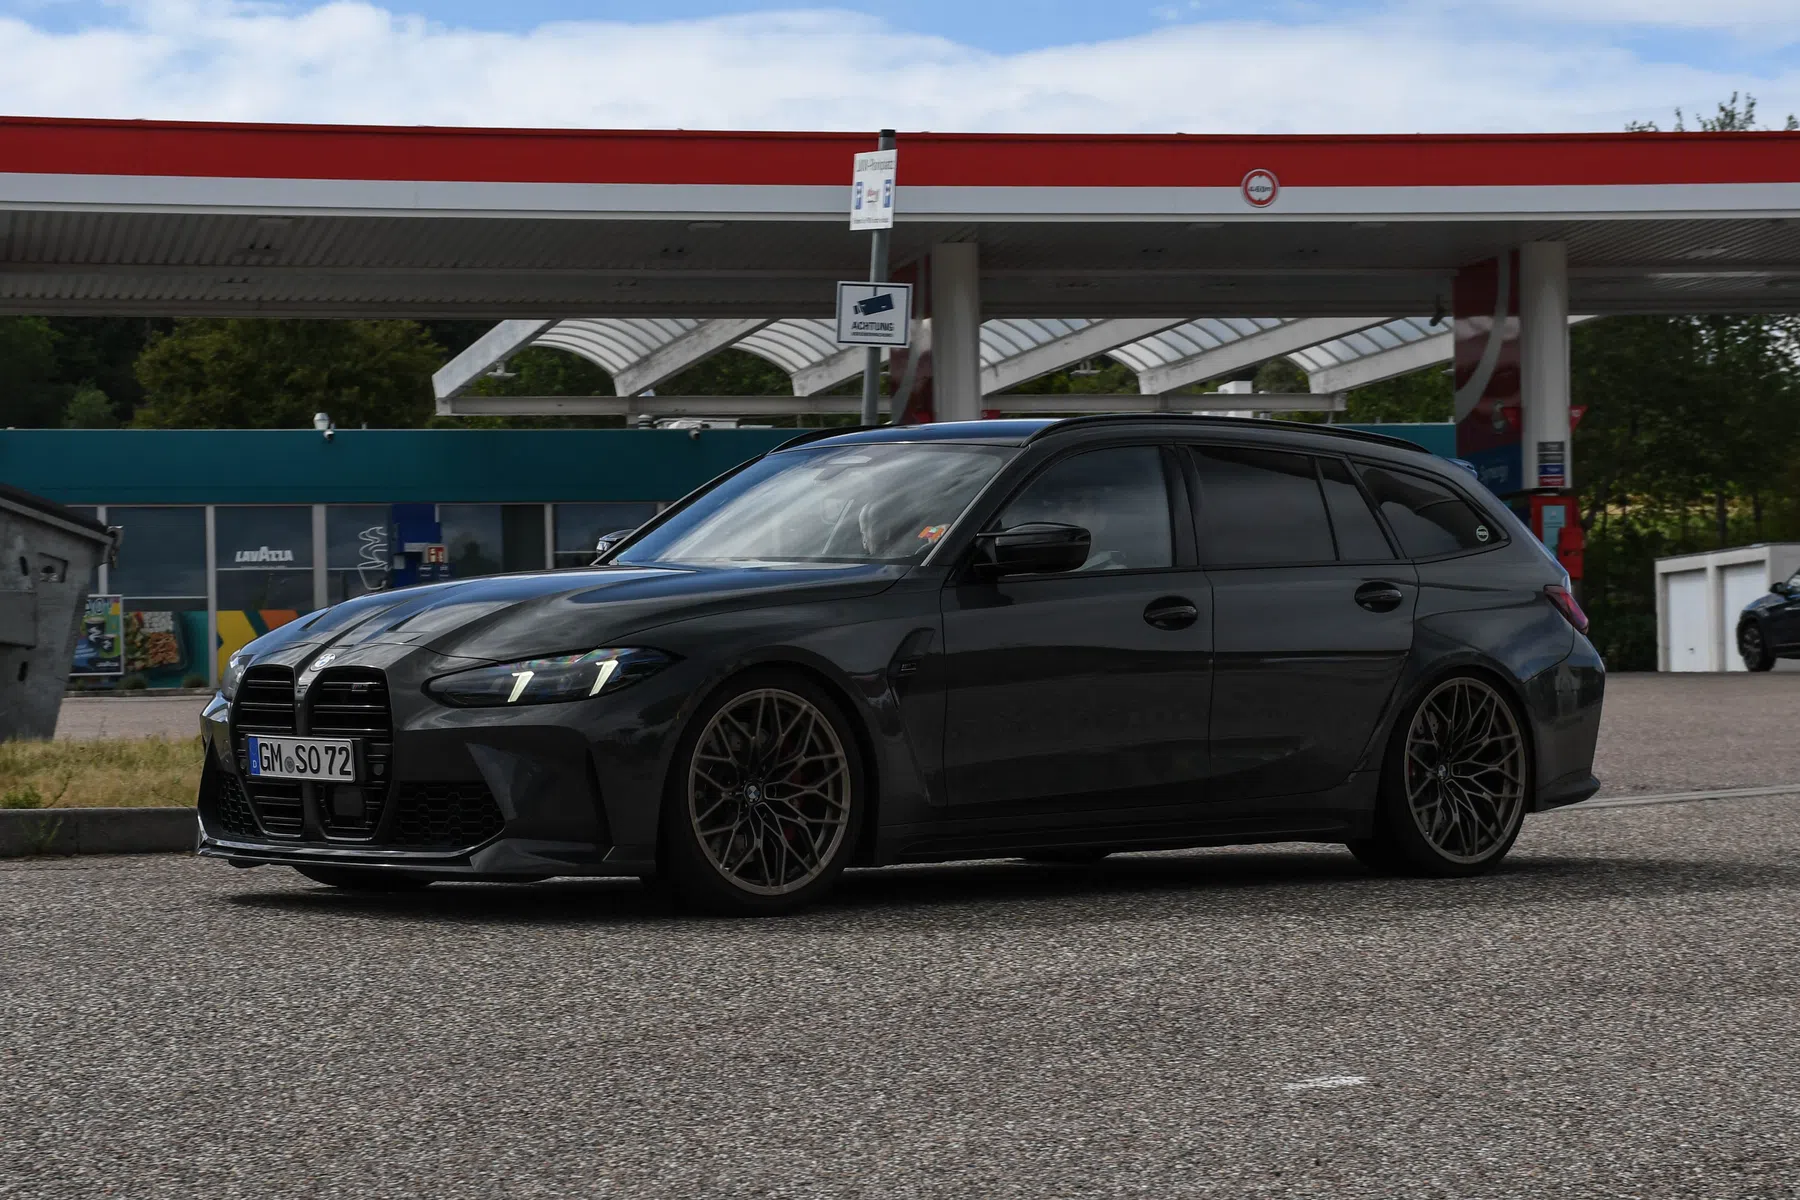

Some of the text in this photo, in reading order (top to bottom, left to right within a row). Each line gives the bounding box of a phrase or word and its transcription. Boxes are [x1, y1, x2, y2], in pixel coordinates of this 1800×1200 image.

[851, 321, 895, 332] ACHTUNG
[235, 545, 294, 563] LAVAZZA
[259, 742, 352, 776] GM SO 72
